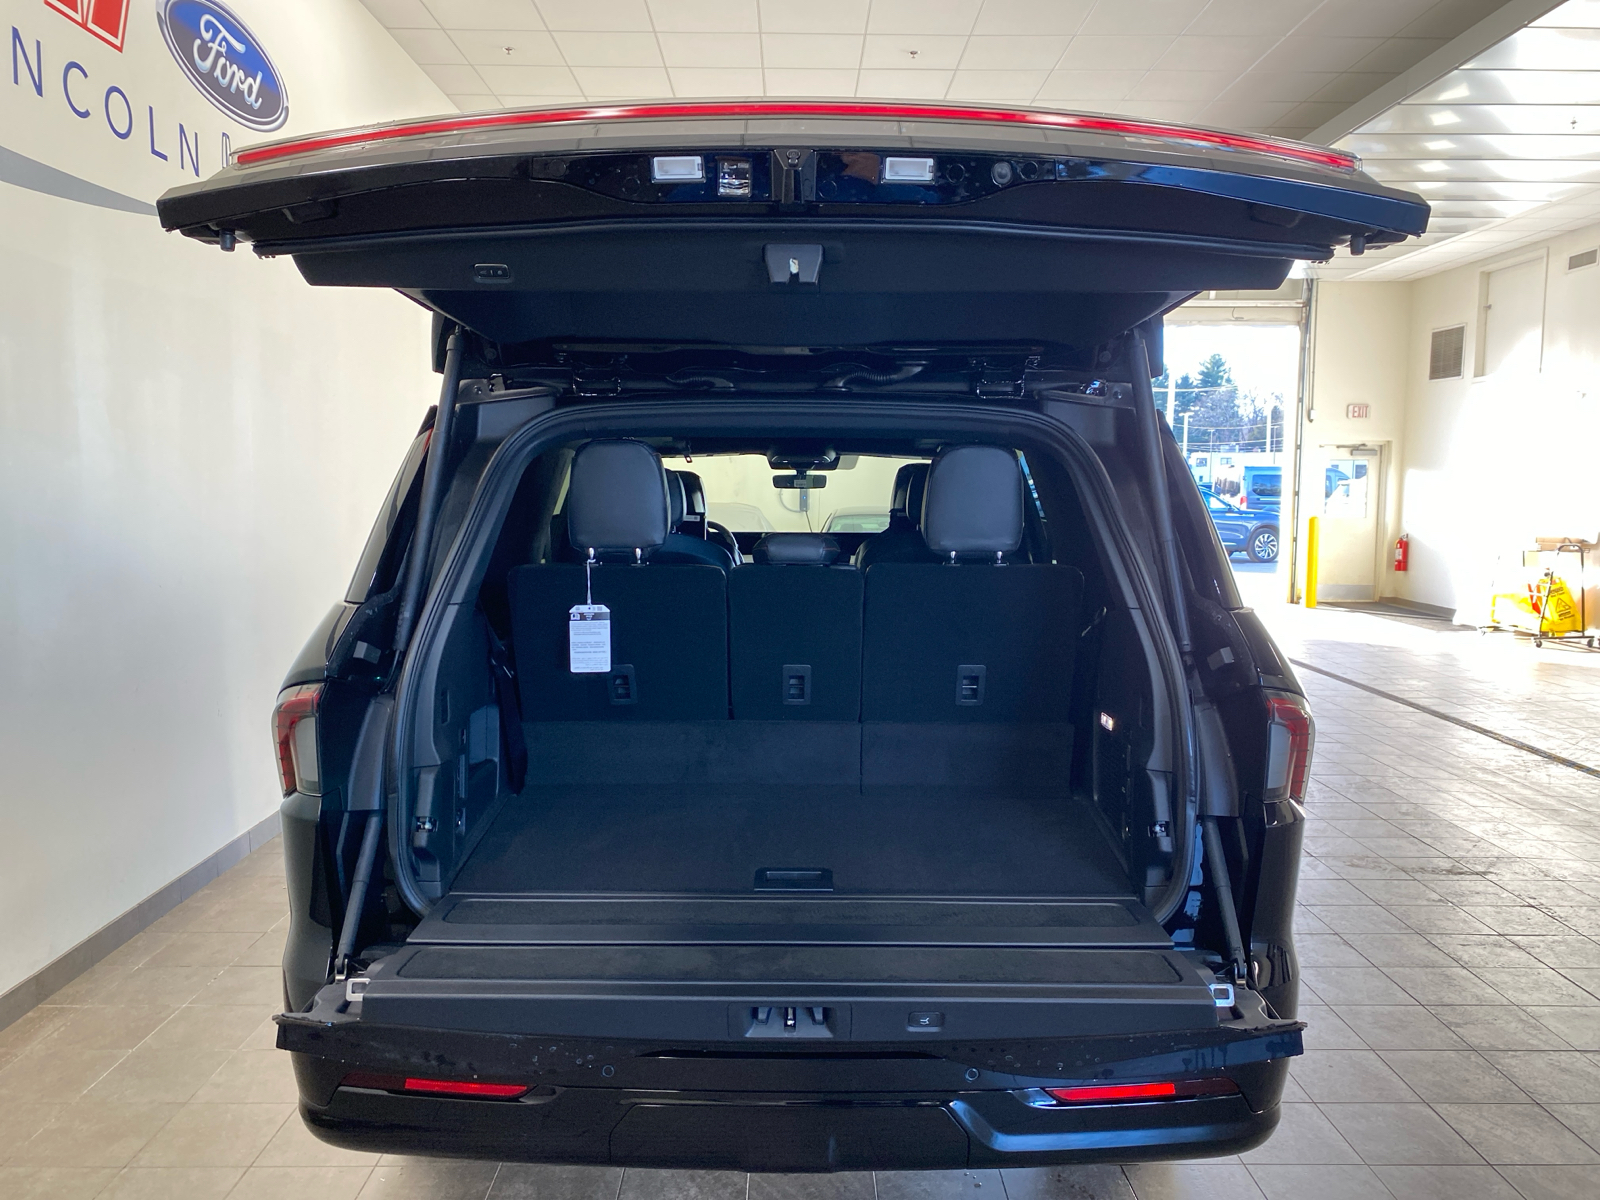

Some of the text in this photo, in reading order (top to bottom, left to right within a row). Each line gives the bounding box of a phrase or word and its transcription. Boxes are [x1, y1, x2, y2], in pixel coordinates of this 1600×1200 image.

[12, 25, 200, 178] NCOLN
[193, 13, 262, 109] Ford
[1352, 405, 1369, 418] EXIT
